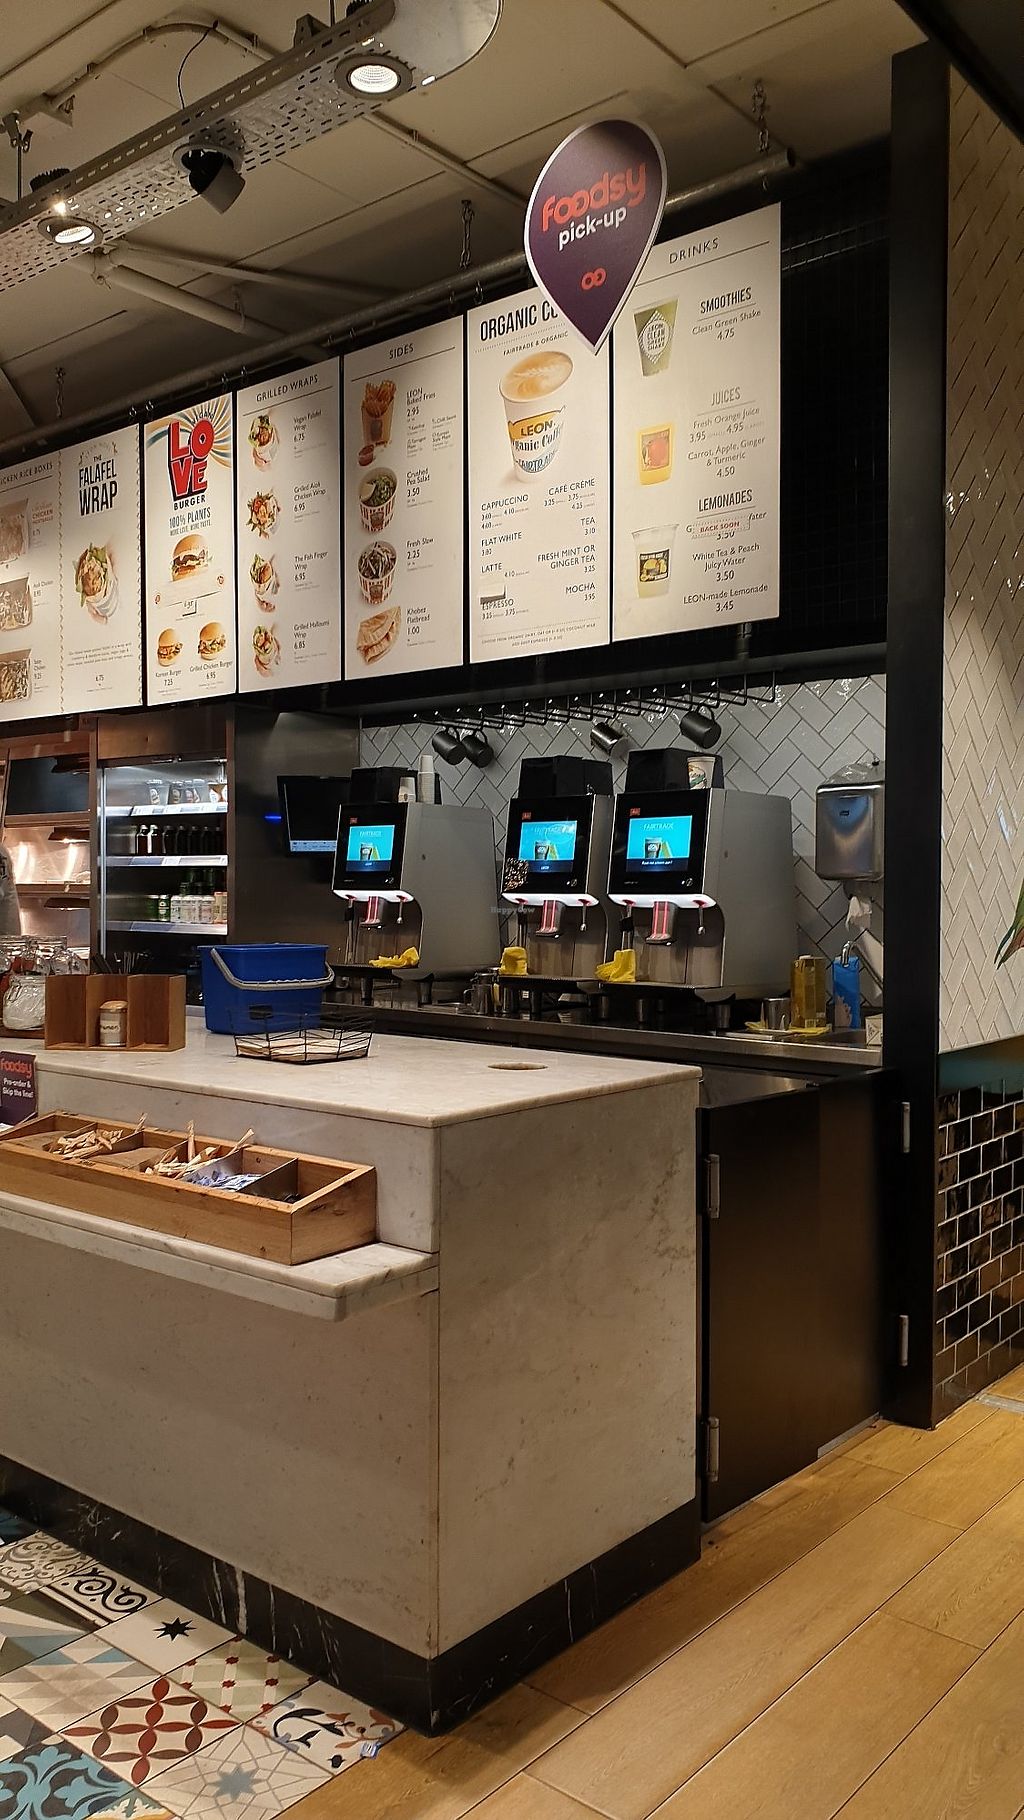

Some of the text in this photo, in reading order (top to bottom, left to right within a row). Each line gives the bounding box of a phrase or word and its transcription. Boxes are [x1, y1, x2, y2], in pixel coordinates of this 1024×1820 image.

[541, 162, 647, 231] foodsy
[558, 206, 627, 251] pick-up
[669, 237, 720, 264] DRINKS
[700, 287, 752, 314] SMOOTHIES
[480, 304, 537, 342] ORGANIC
[692, 309, 761, 335] Clean Green Shake
[503, 341, 534, 356] FAIRTRADE
[541, 331, 569, 345] ORGANIC
[717, 328, 735, 341] 4.75
[389, 343, 414, 360] SIDES
[256, 374, 319, 402] GRILLED WRAPS
[711, 387, 741, 406] JUICES
[693, 408, 760, 429] Fresh Orange Juice
[689, 431, 706, 443] 3.95
[726, 421, 744, 433] 4.95
[740, 436, 765, 448] Ginger
[706, 452, 746, 466] & Turmeric
[79, 459, 117, 487] FALAFEL
[716, 465, 735, 477] 4.50
[80, 480, 118, 517] WRAP
[173, 494, 206, 511] BURGER
[481, 494, 529, 511] CAPPUCCINO
[698, 489, 753, 512] LEMONADES
[169, 506, 211, 529] 100% PLANTS
[580, 516, 596, 526] TEA
[699, 525, 719, 534] BACK
[720, 521, 740, 531] SOON
[406, 539, 421, 548] Fresh
[481, 531, 522, 547] FLAT WHITE
[537, 544, 596, 562] FRESH MINT OR
[692, 542, 760, 562] White Tea & Peach
[481, 562, 503, 573] LATTE
[550, 554, 596, 570] GINGER TEA
[704, 557, 746, 573] Juicy Water
[716, 569, 735, 582] 3.50
[565, 582, 596, 595] MOCHA
[683, 584, 768, 604] LEON-made Lemonade
[715, 600, 734, 612] 3.45
[0, 1058, 33, 1079] foodsy
[2, 1086, 14, 1097] Skip
